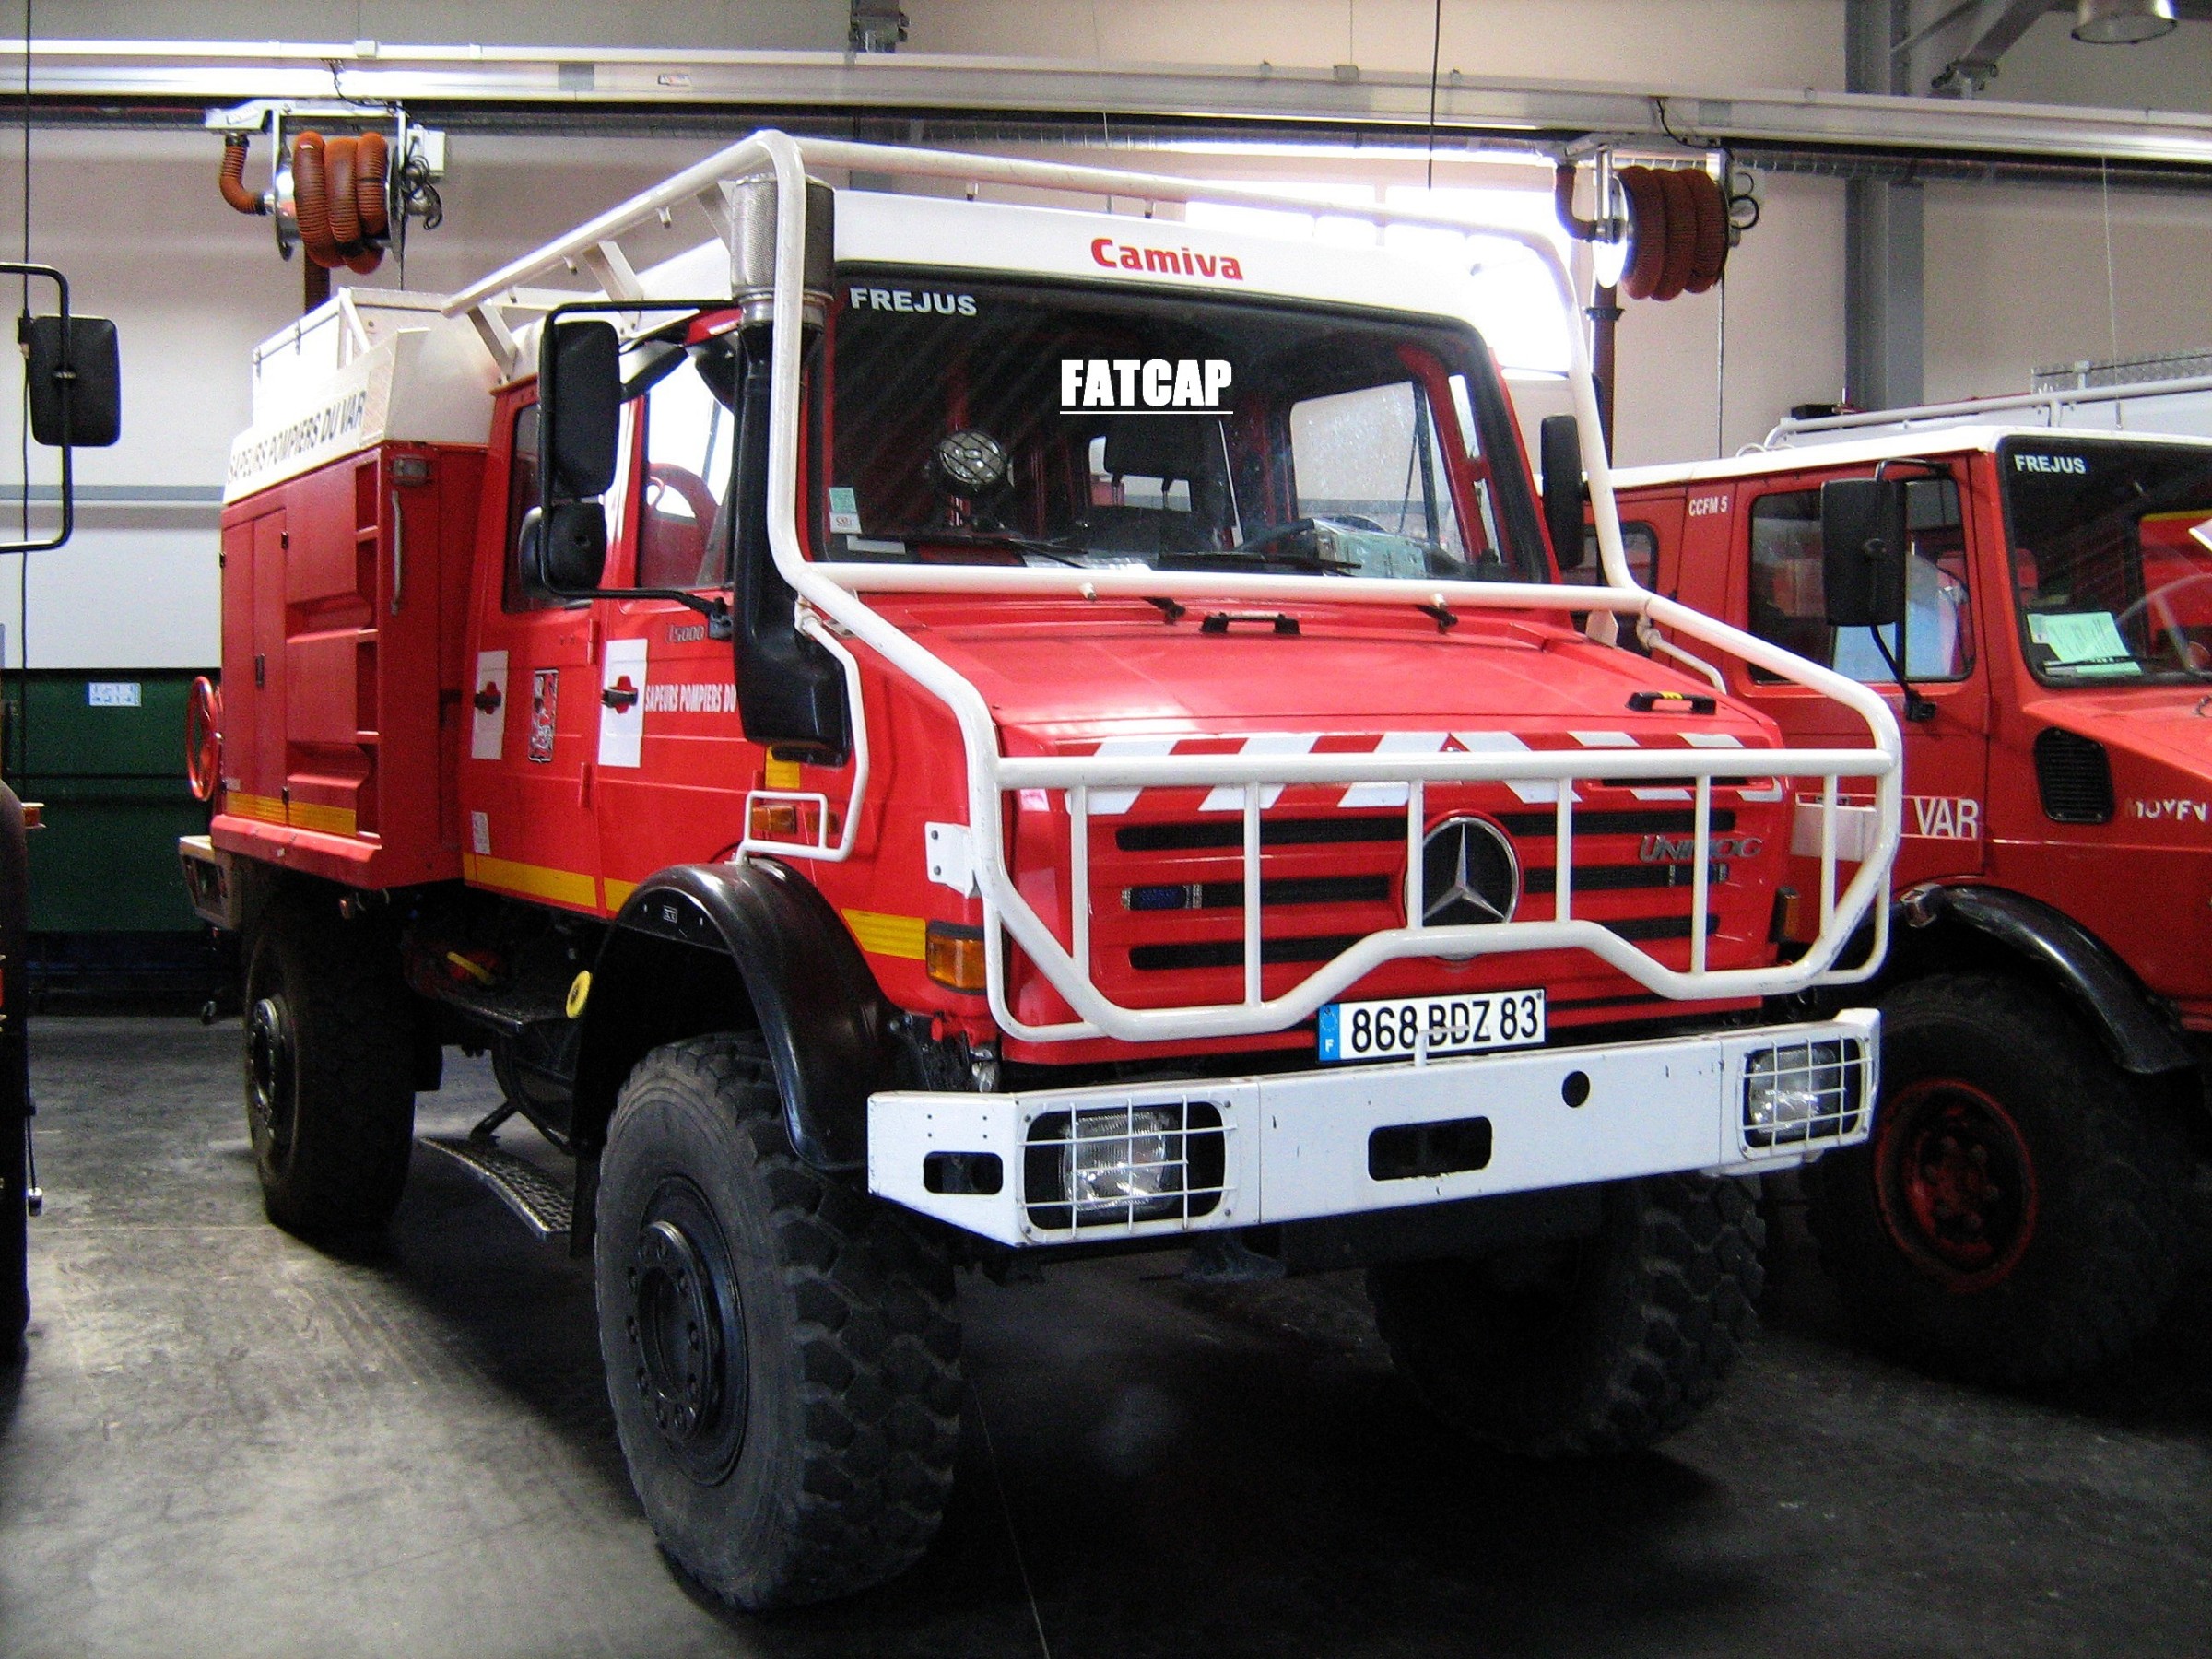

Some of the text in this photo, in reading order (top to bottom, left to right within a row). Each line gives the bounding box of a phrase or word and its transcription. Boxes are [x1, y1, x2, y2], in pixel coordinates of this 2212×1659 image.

[1091, 237, 1244, 281] Camiva
[850, 288, 978, 316] FREJUS
[278, 411, 322, 463] POMPIERS
[321, 401, 342, 443] DU
[340, 389, 367, 435] VAR
[2013, 453, 2087, 475] FREJUS
[1688, 495, 1728, 517] CCFM 5
[645, 684, 678, 712] SAPEURS
[679, 683, 722, 712] POMPIERS
[1913, 796, 1980, 840] VAR
[1351, 994, 1538, 1053] 868 BDZ 83
[1324, 1038, 1335, 1053] F
